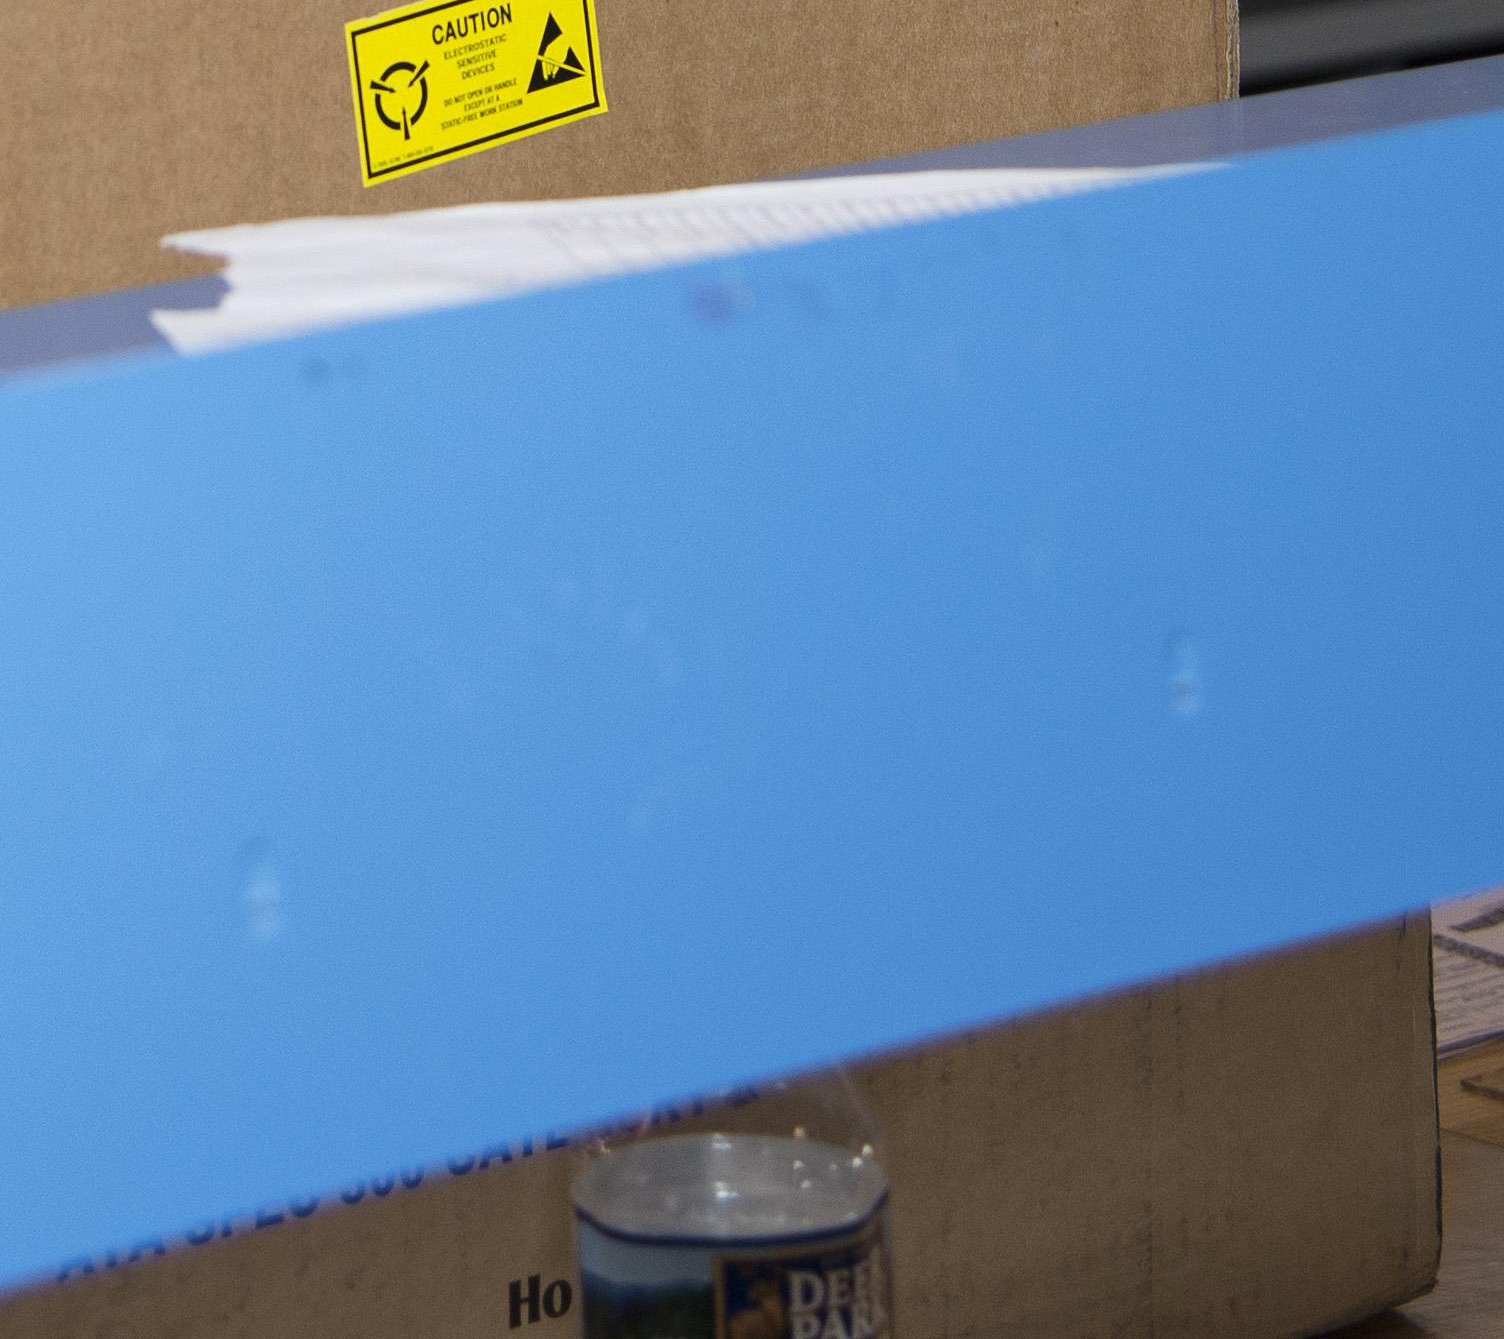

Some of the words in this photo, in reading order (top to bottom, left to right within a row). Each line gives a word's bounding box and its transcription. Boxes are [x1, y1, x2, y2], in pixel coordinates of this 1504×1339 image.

[432, 3, 512, 45] CAUTION
[444, 34, 507, 60] ELECTROSTATIC
[457, 49, 496, 69] SENSITIVE
[461, 63, 495, 80] DEVICES
[444, 97, 453, 107] DO
[454, 93, 465, 103] NOT
[467, 89, 483, 99] OPEN
[494, 78, 517, 91] HANDLE
[464, 98, 485, 112] EXCEPT
[479, 107, 496, 118] WORK
[499, 98, 523, 112] STATION
